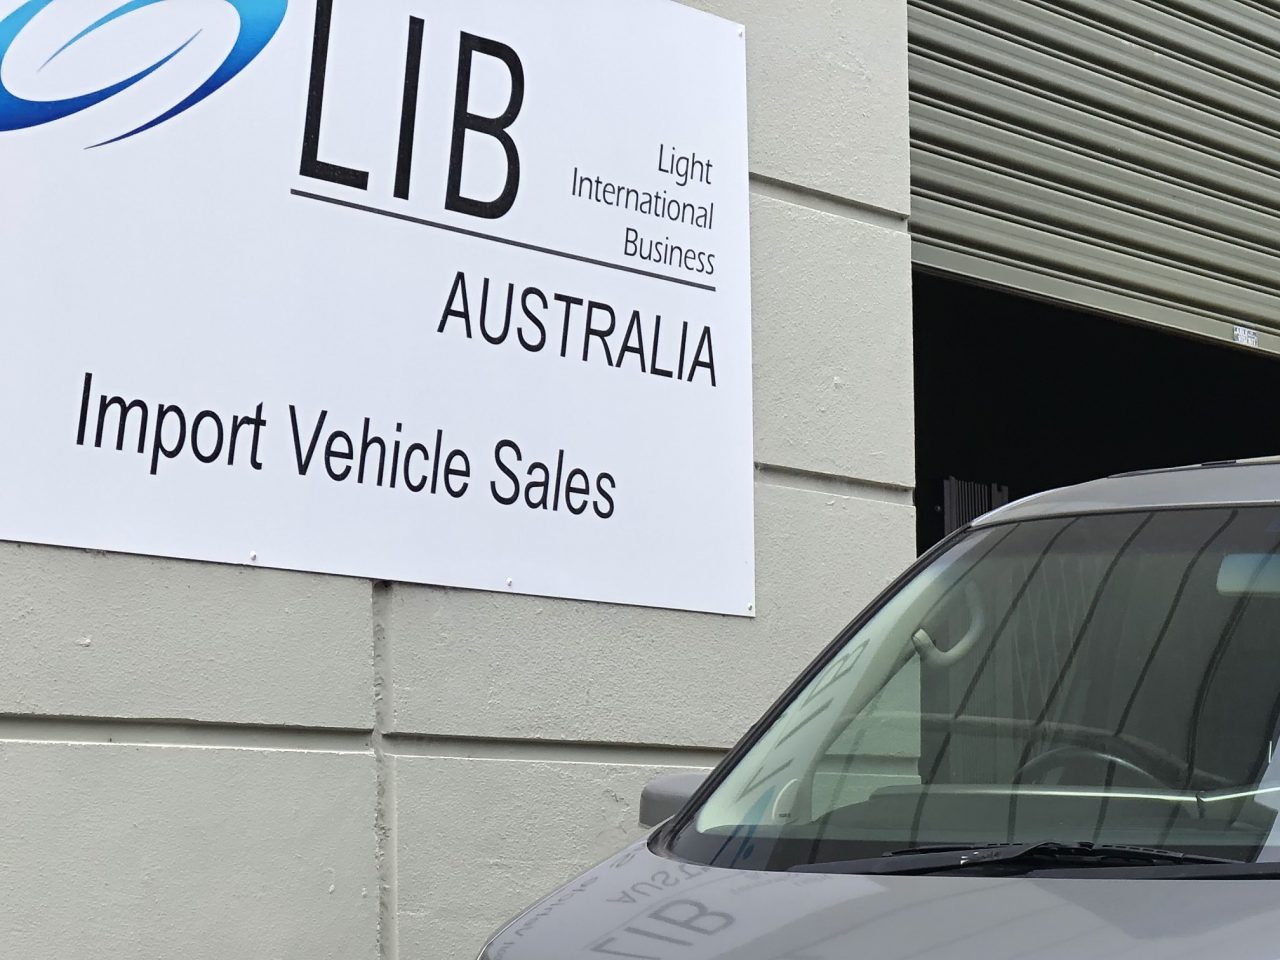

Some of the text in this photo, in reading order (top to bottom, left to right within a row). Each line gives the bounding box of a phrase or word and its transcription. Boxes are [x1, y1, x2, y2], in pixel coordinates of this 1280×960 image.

[298, 0, 525, 220] LIB
[571, 168, 714, 230] International
[658, 144, 713, 187] Light
[623, 228, 716, 275] Business
[436, 272, 717, 388] AUSTRALIA
[76, 372, 616, 520] Import Vehicle Sales
